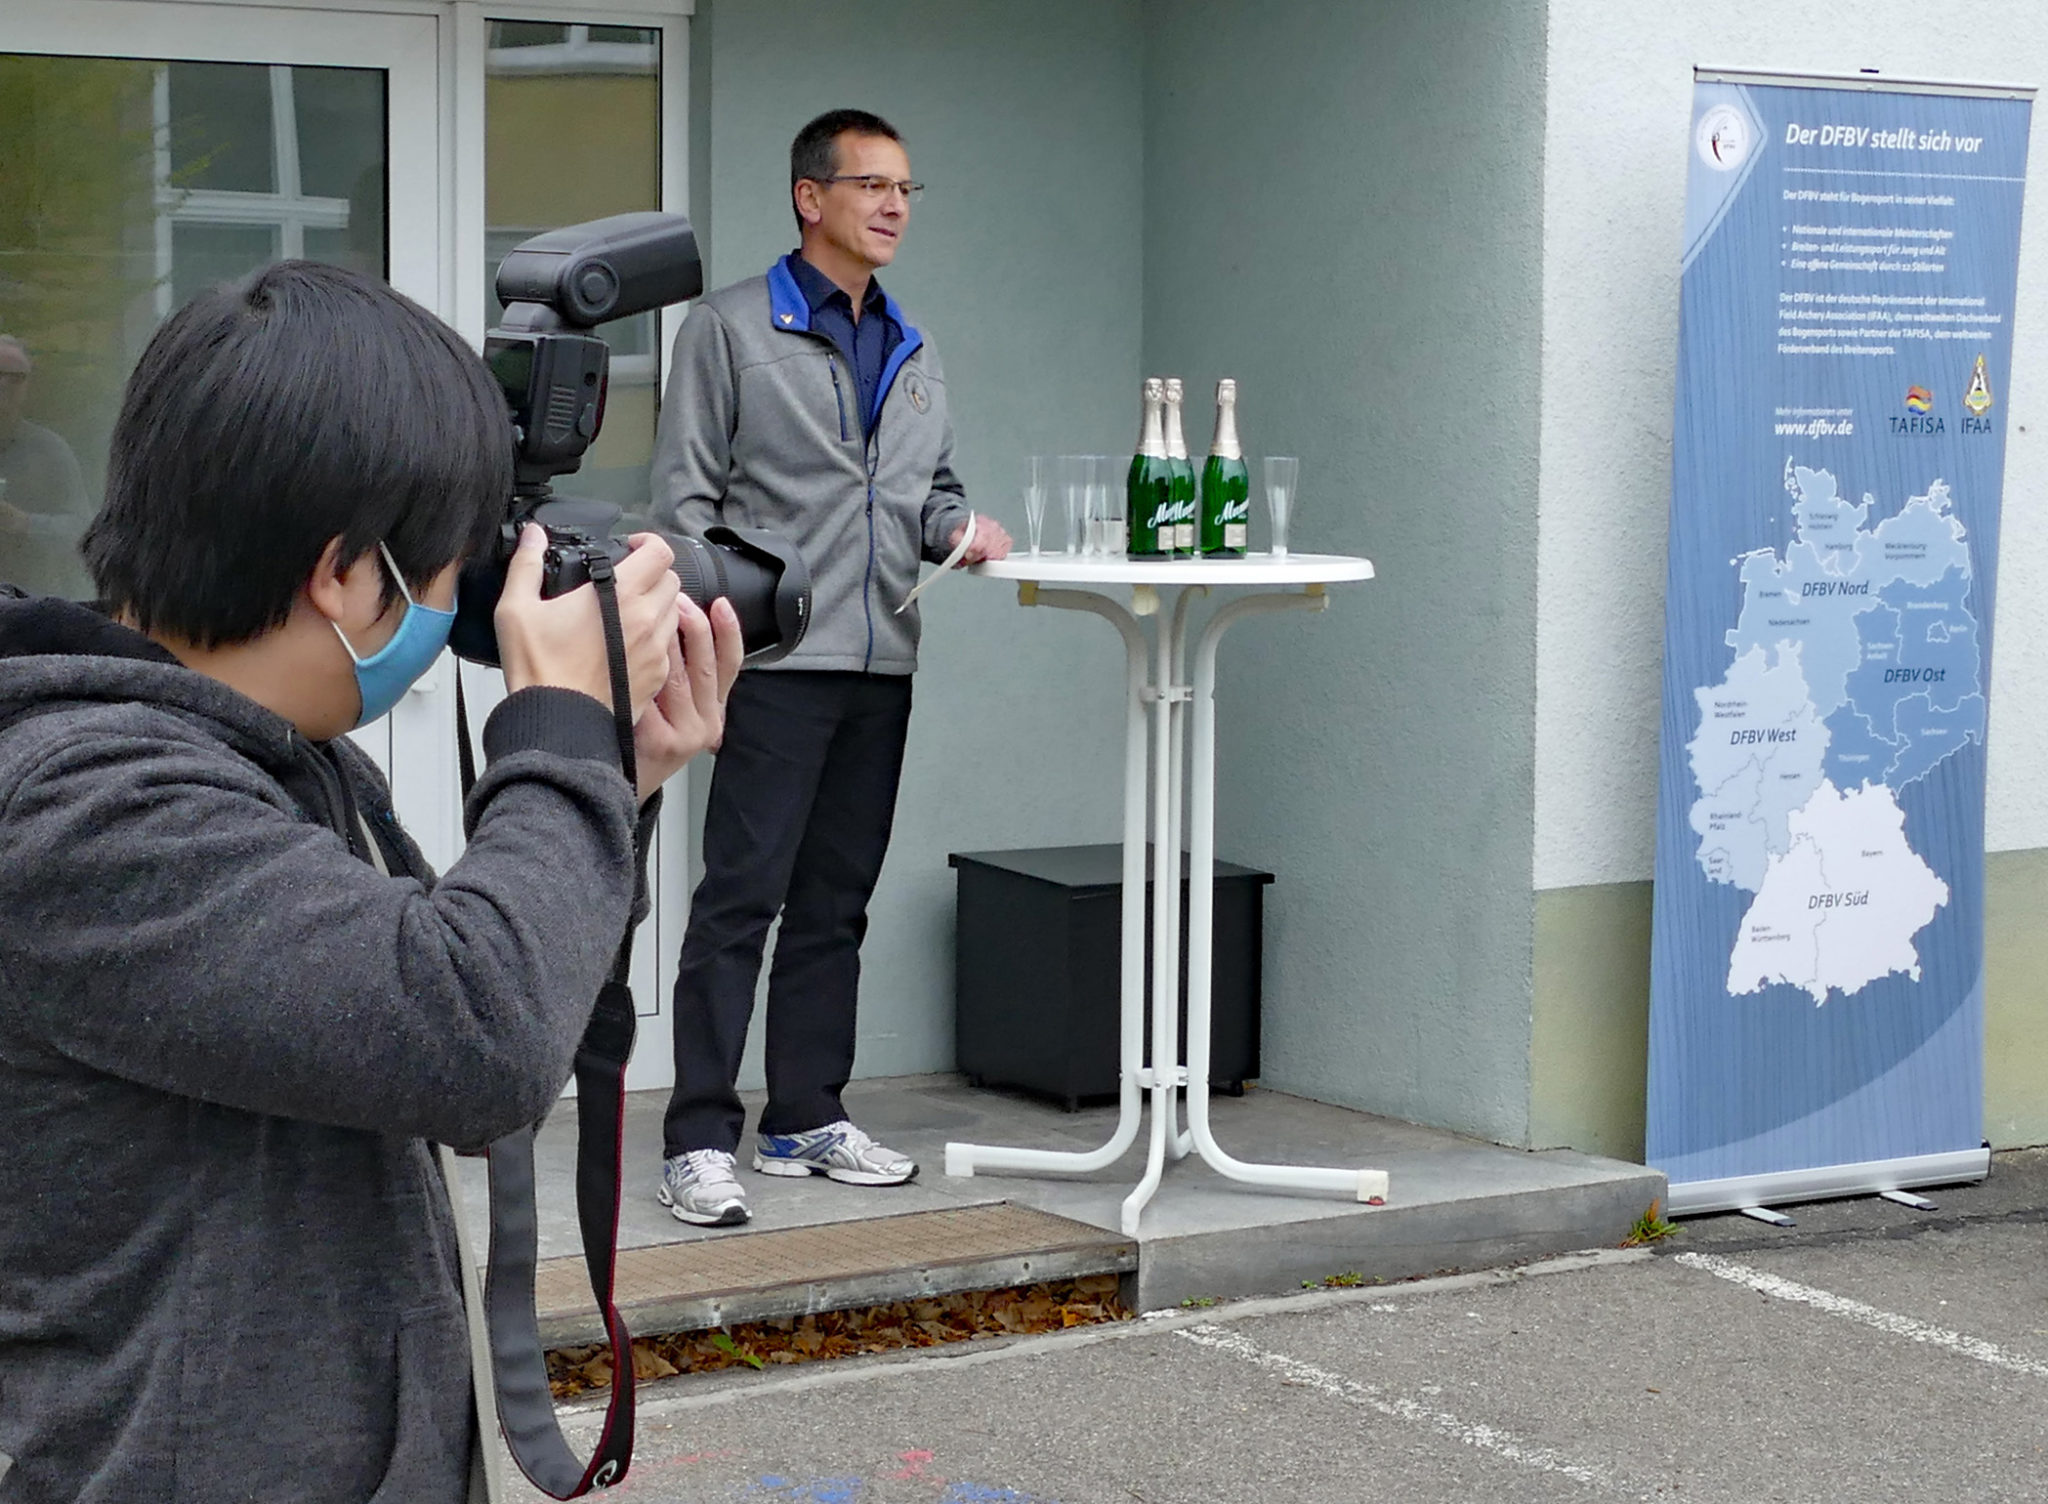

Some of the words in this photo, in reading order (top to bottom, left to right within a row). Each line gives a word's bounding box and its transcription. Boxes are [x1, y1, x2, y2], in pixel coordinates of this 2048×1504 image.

[1786, 123, 1818, 144] Der
[1820, 124, 1870, 147] DFBV
[1870, 127, 1915, 149] stellt
[1918, 129, 1951, 151] sich
[1954, 136, 1983, 153] vor
[1783, 189, 1796, 200] Der
[1798, 190, 1819, 201] DFBV
[1775, 419, 1853, 440] www.dfbv.de
[1889, 416, 1945, 434] TAFISA
[1961, 418, 1992, 434] IFAA
[1802, 582, 1835, 596] DFBV
[1838, 580, 1870, 596] Nord
[1884, 668, 1921, 683] DFBV
[1923, 668, 1946, 682] Ost
[1730, 730, 1766, 745] DFBV
[1767, 728, 1796, 742] West
[1808, 893, 1845, 909] DFBV
[1845, 890, 1869, 907] Süd
